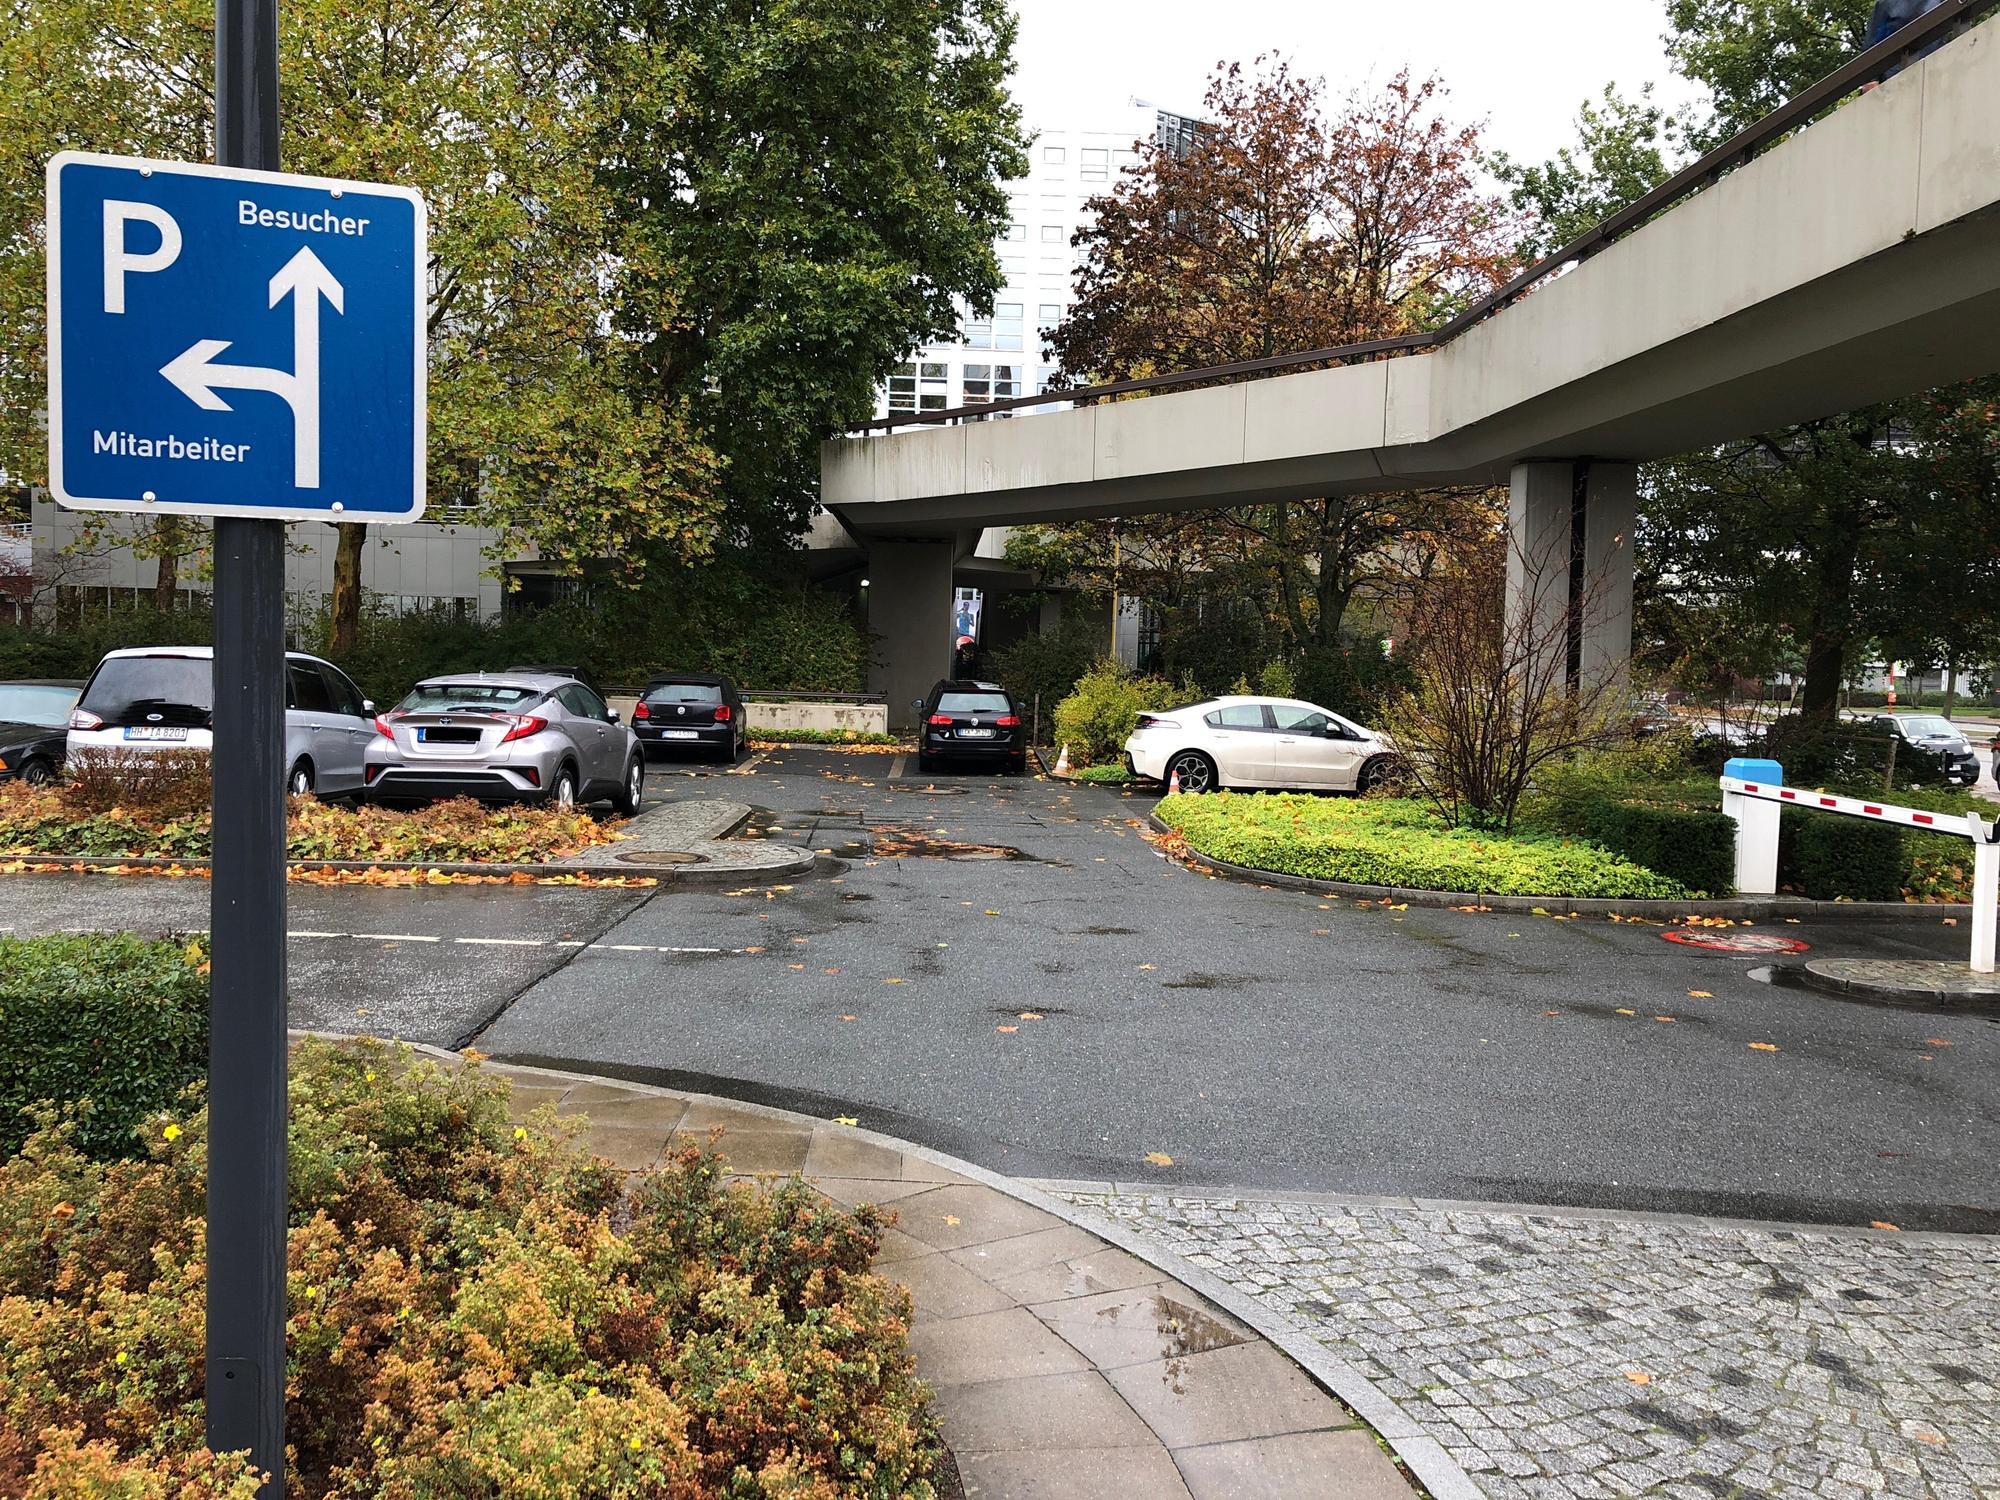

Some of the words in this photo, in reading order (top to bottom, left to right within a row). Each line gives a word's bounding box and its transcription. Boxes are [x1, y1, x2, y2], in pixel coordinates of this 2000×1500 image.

[239, 200, 370, 236] Besucher
[103, 199, 183, 314] P
[94, 430, 250, 462] Mitarbeiter
[130, 727, 143, 737] HH
[150, 727, 161, 737] IA
[163, 727, 186, 738] 8201
